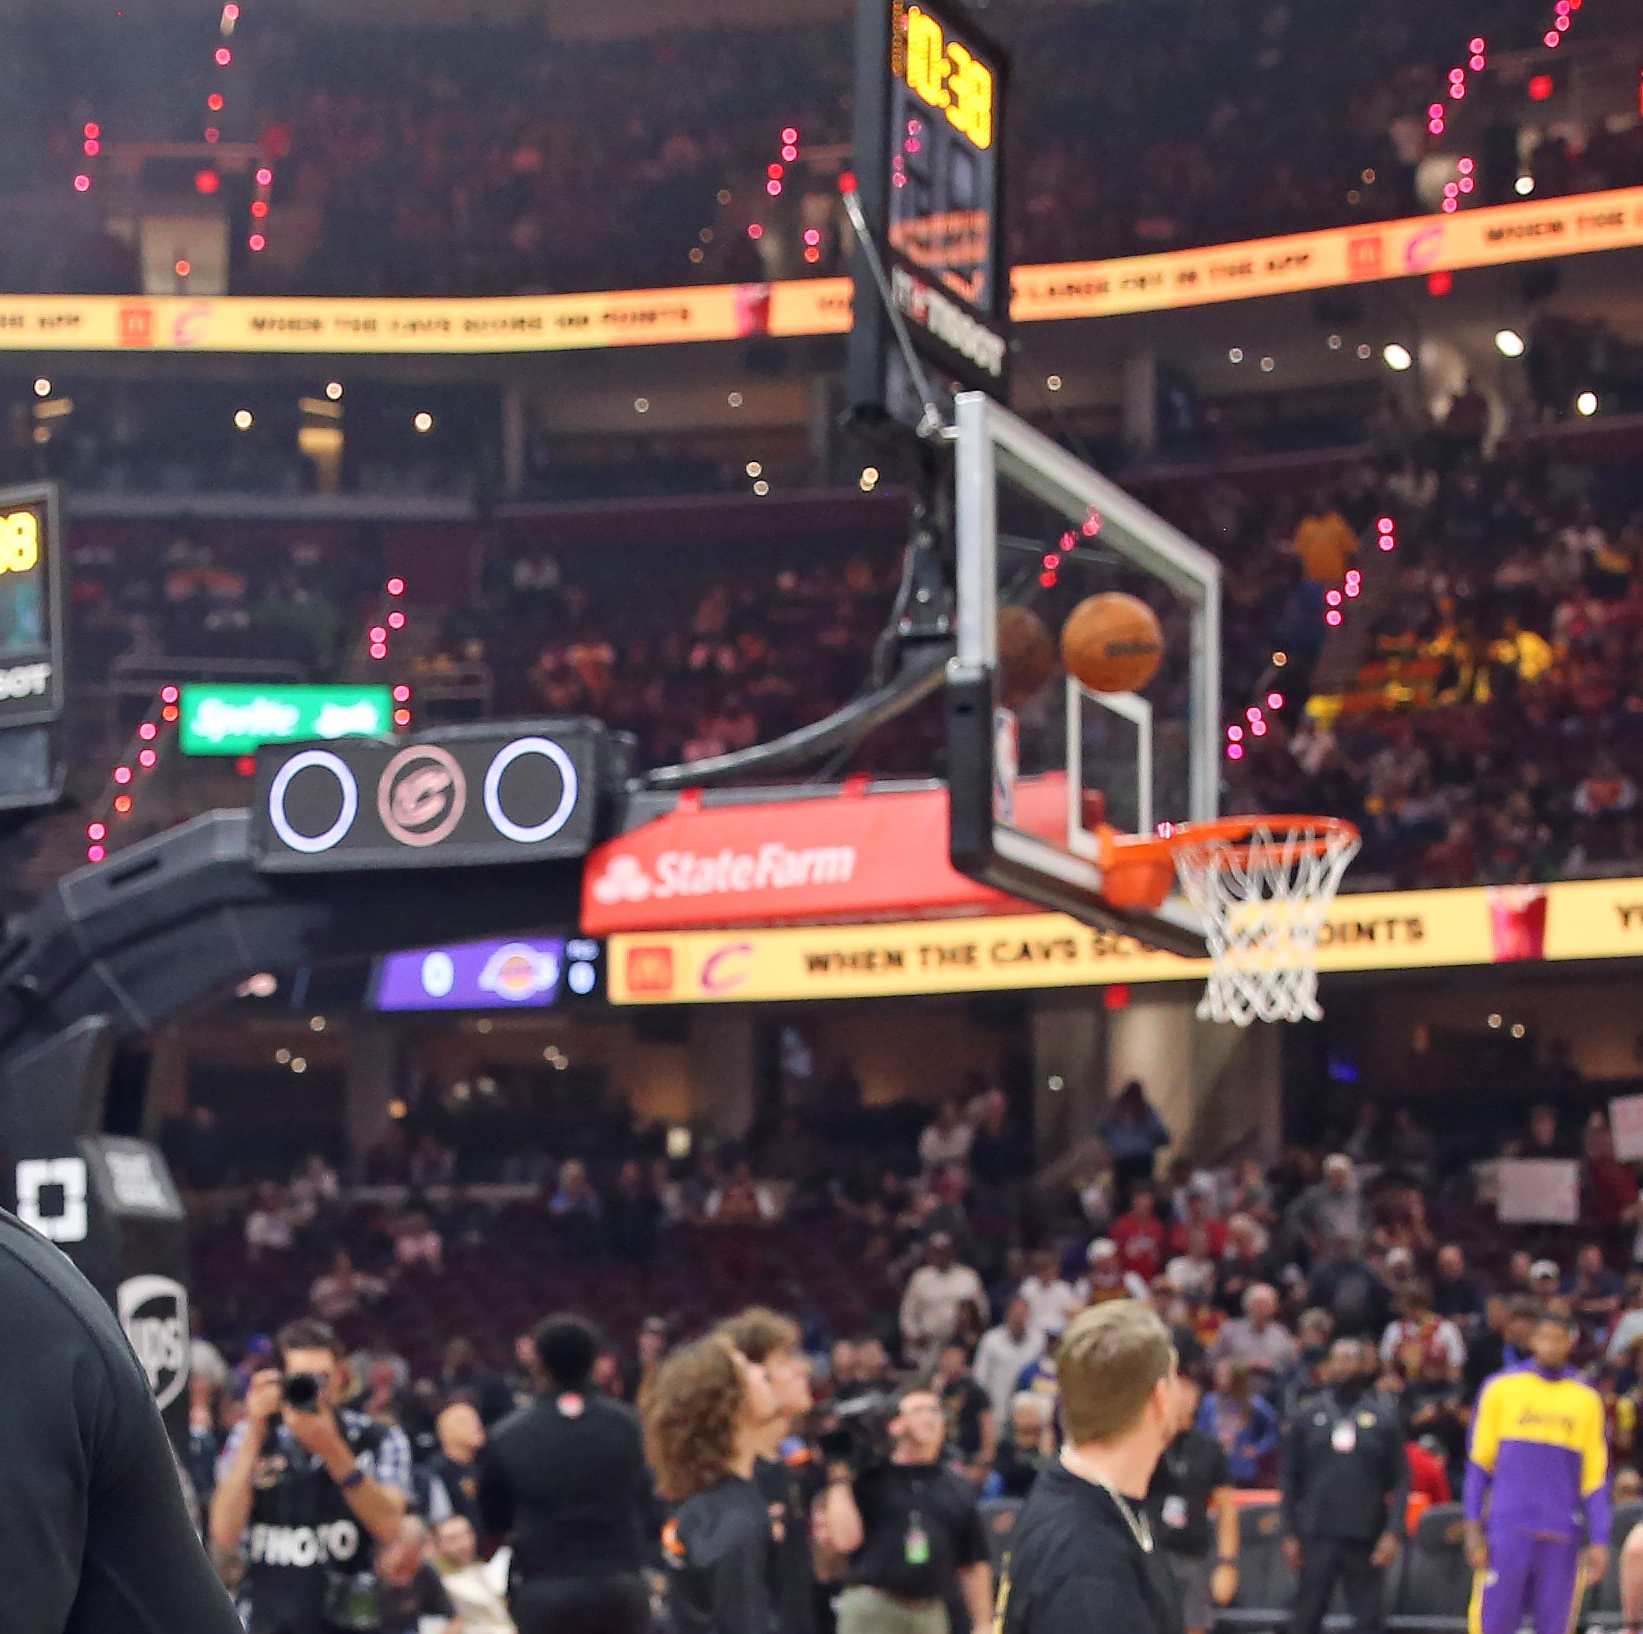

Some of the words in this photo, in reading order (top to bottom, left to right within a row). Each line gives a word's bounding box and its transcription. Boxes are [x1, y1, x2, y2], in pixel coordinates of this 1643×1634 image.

[804, 946, 904, 975] WHEN
[918, 944, 979, 968] THE
[990, 937, 1078, 964] CAVS
